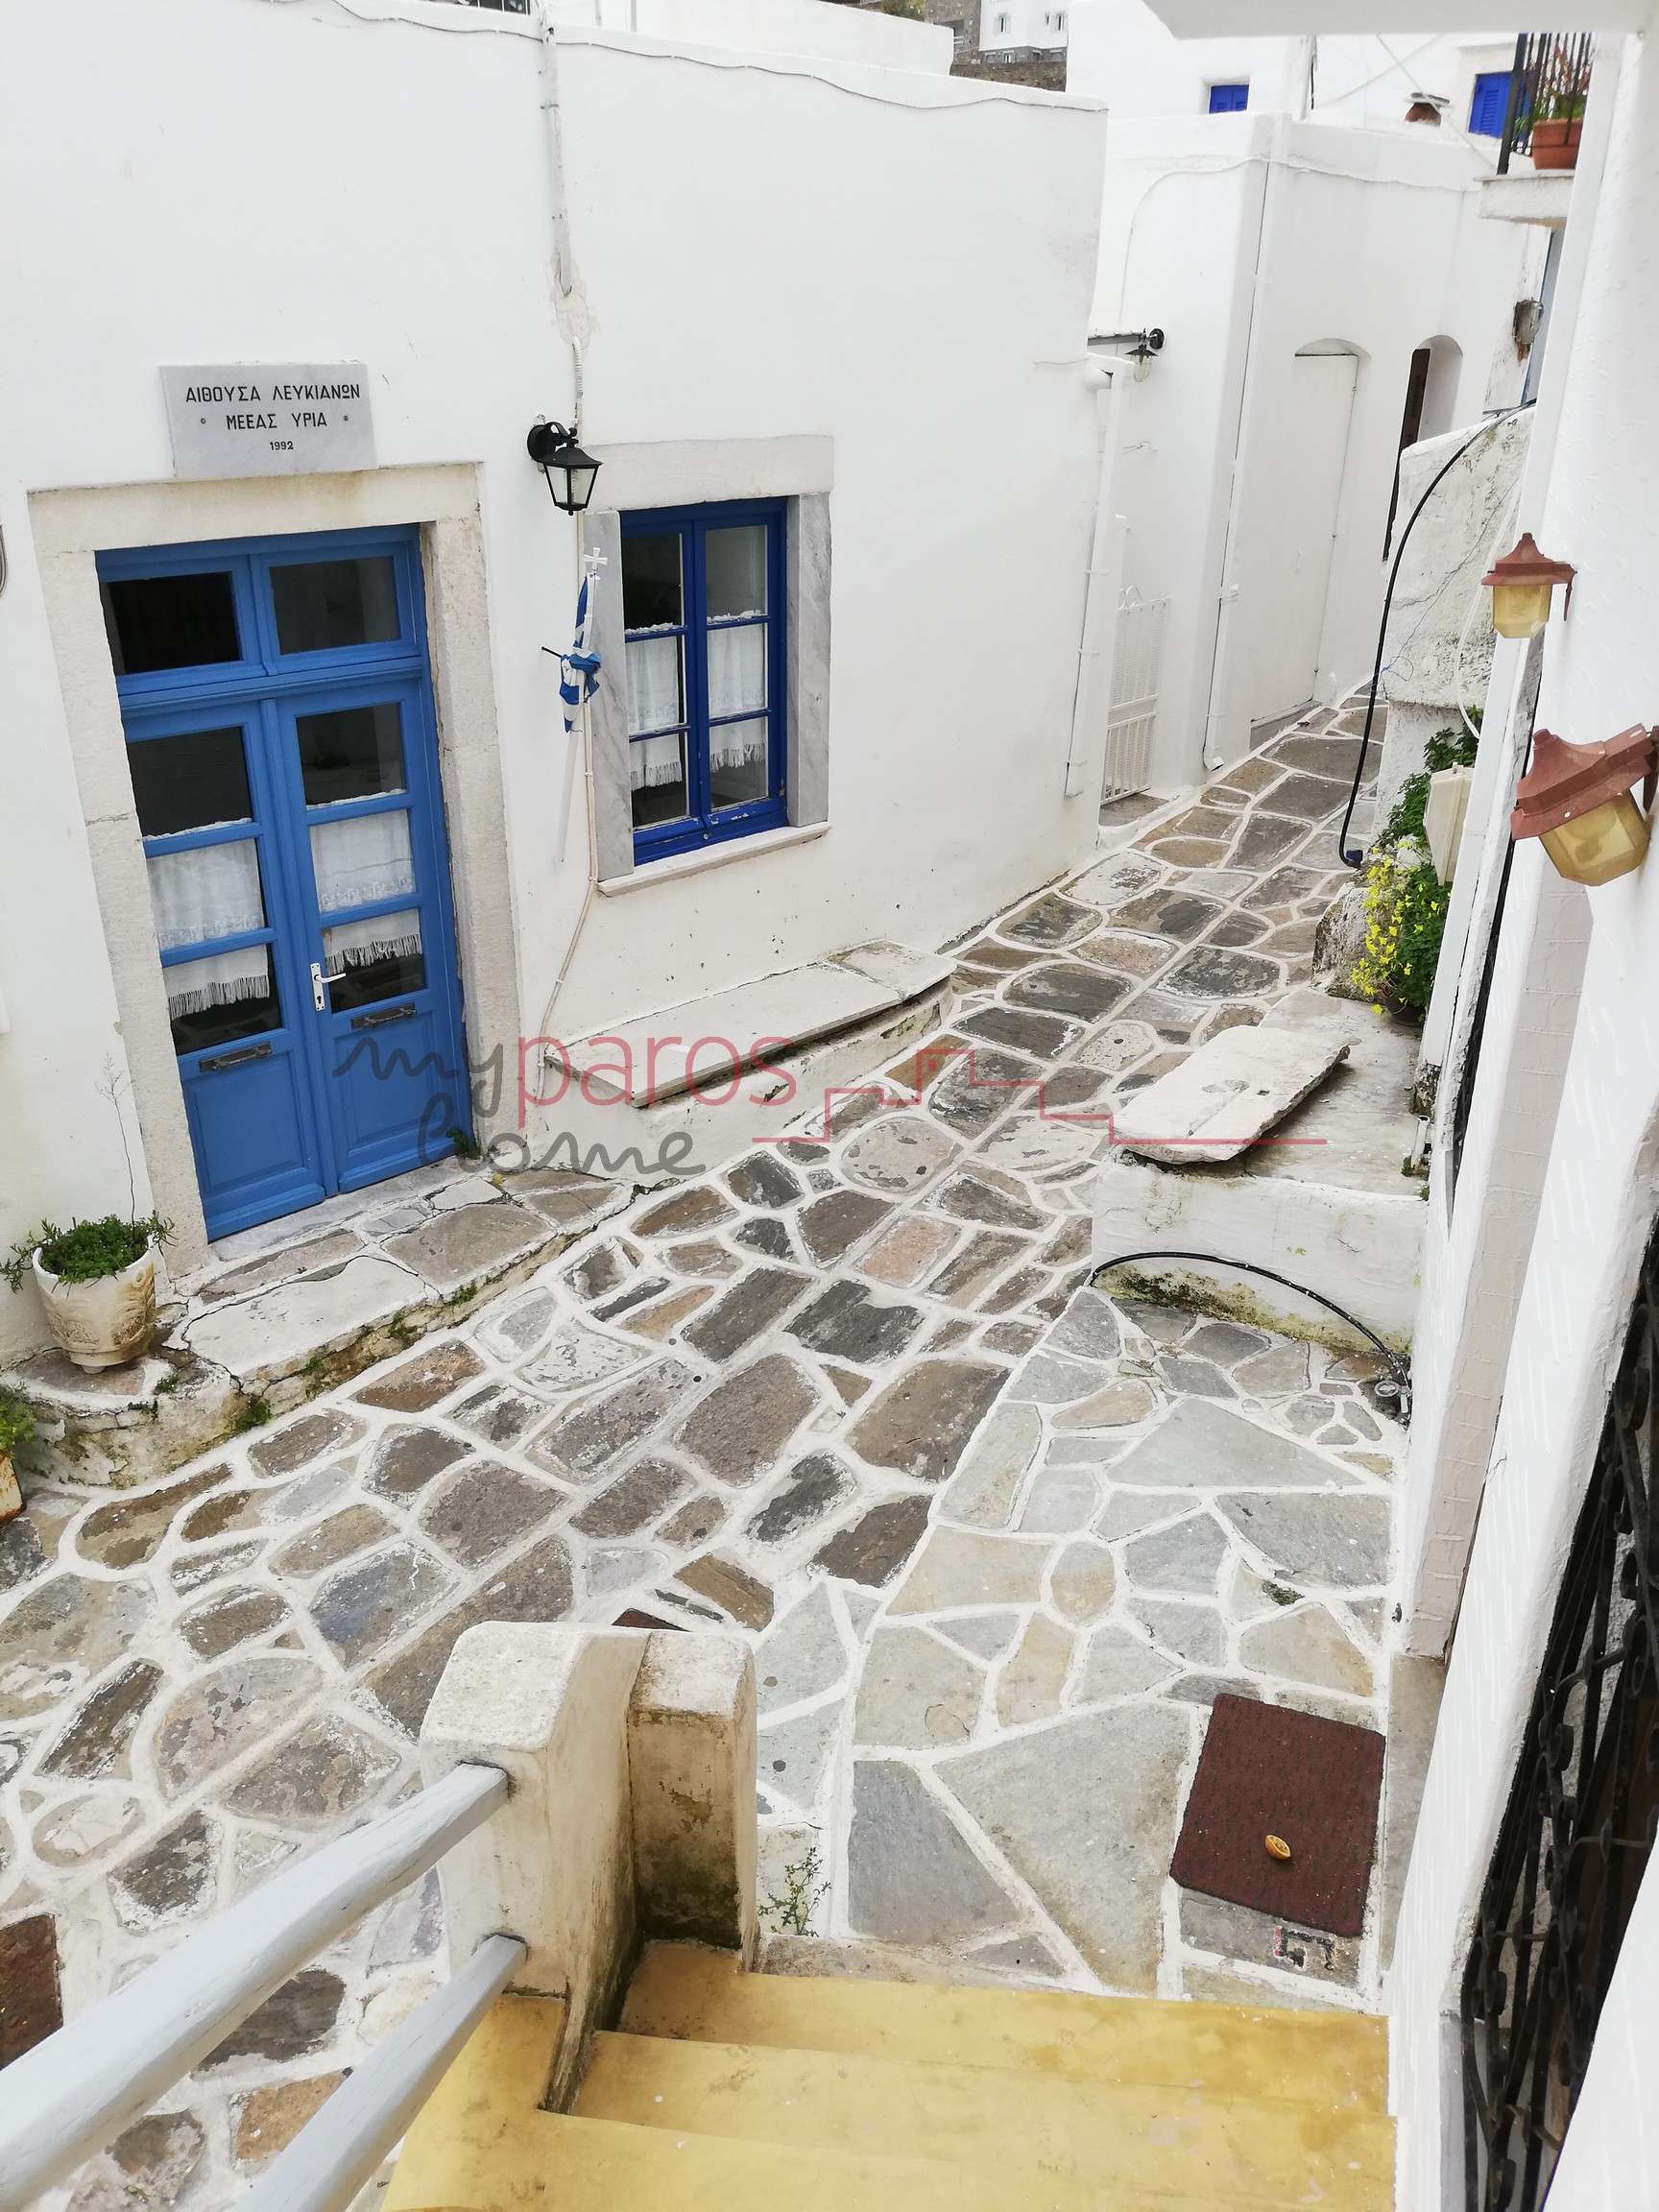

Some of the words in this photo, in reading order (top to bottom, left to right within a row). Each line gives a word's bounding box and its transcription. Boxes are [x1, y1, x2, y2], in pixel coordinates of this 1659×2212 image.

[185, 386, 261, 402] ΑΙΘΟΥΣΑ
[273, 384, 360, 400] ΛΕΥΚΙΑΝΩΝ
[227, 414, 277, 430] ΜΕΕΑΣ
[291, 412, 327, 427] ΥΡΙΑ
[270, 441, 294, 451] 1992
